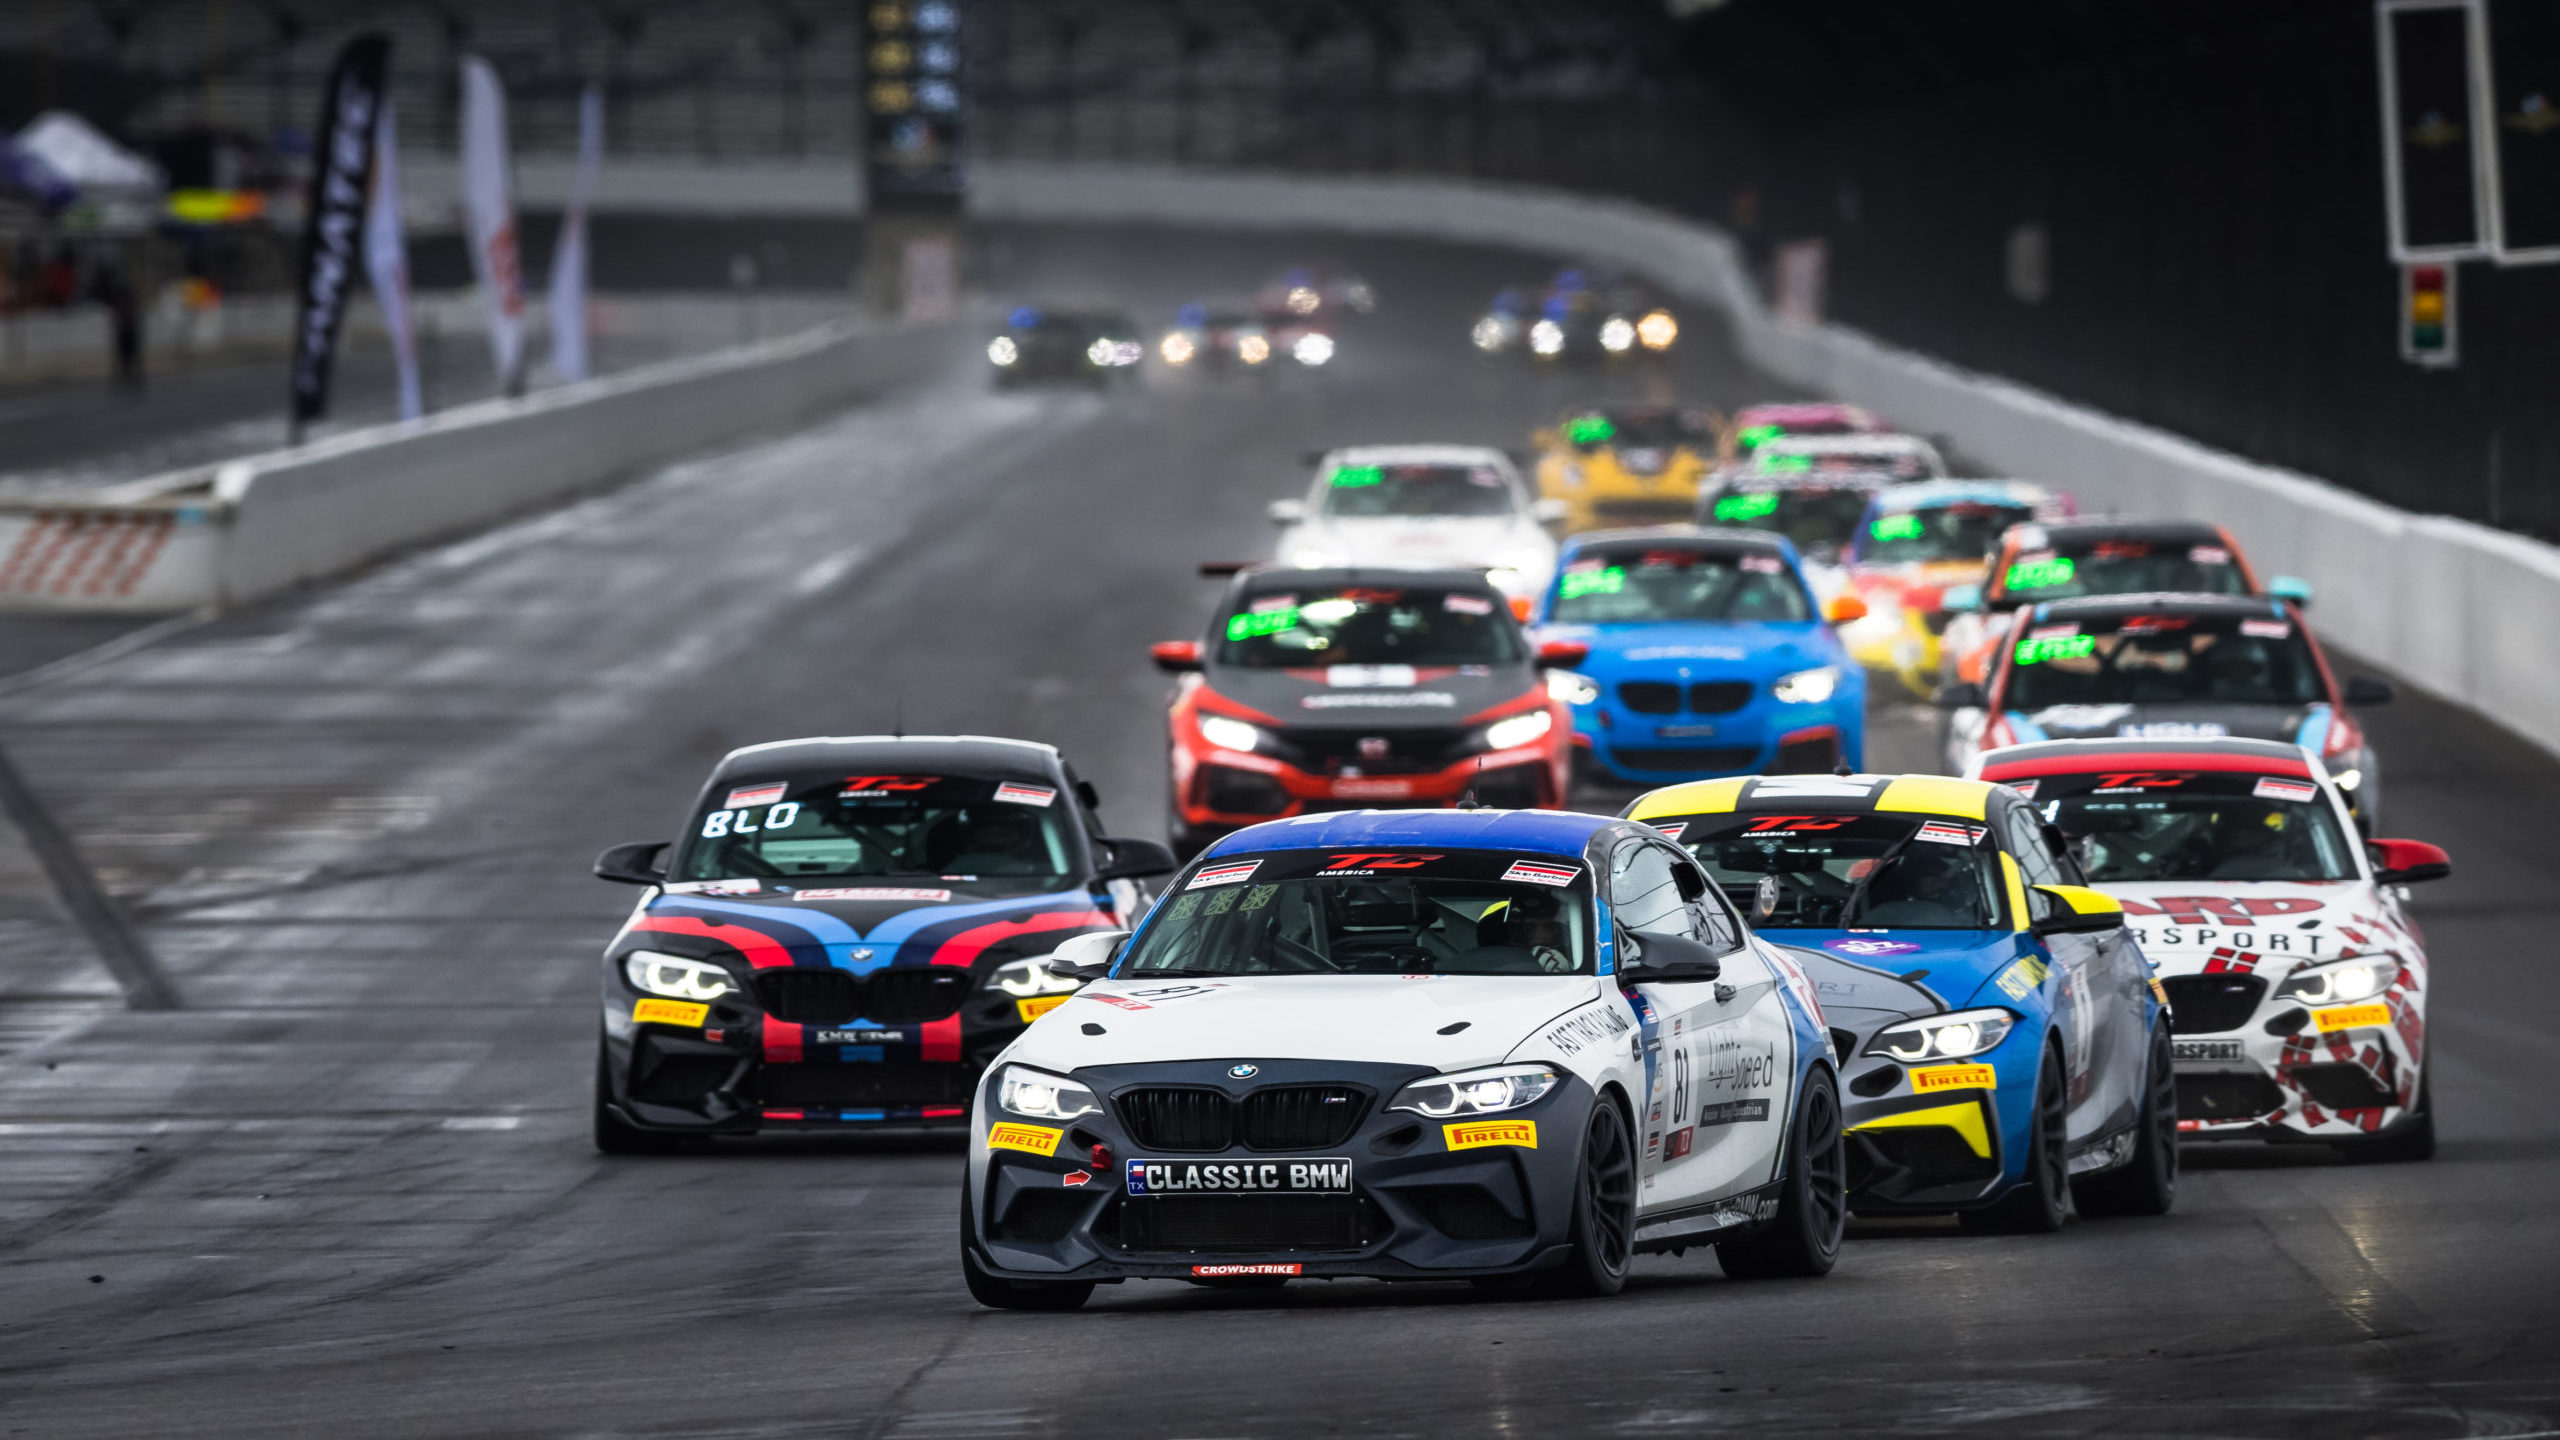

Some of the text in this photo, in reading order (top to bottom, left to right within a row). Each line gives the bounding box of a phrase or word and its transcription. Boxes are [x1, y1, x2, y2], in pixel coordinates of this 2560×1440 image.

[1740, 830, 1796, 839] AMERICA
[1328, 853, 1446, 870] TC
[1316, 868, 1375, 877] AMERICA
[1507, 870, 1570, 882] Skip Barber
[1673, 1046, 1690, 1125] 81
[1917, 1067, 1990, 1088] PIRELLI
[992, 1127, 1054, 1150] PIRELLI
[1452, 1124, 1530, 1145] PIRELLI
[1146, 1163, 1349, 1190] CLASSIC BMW
[1128, 1180, 1146, 1191] TX
[1199, 1264, 1295, 1275] CROWDSTRIKE
